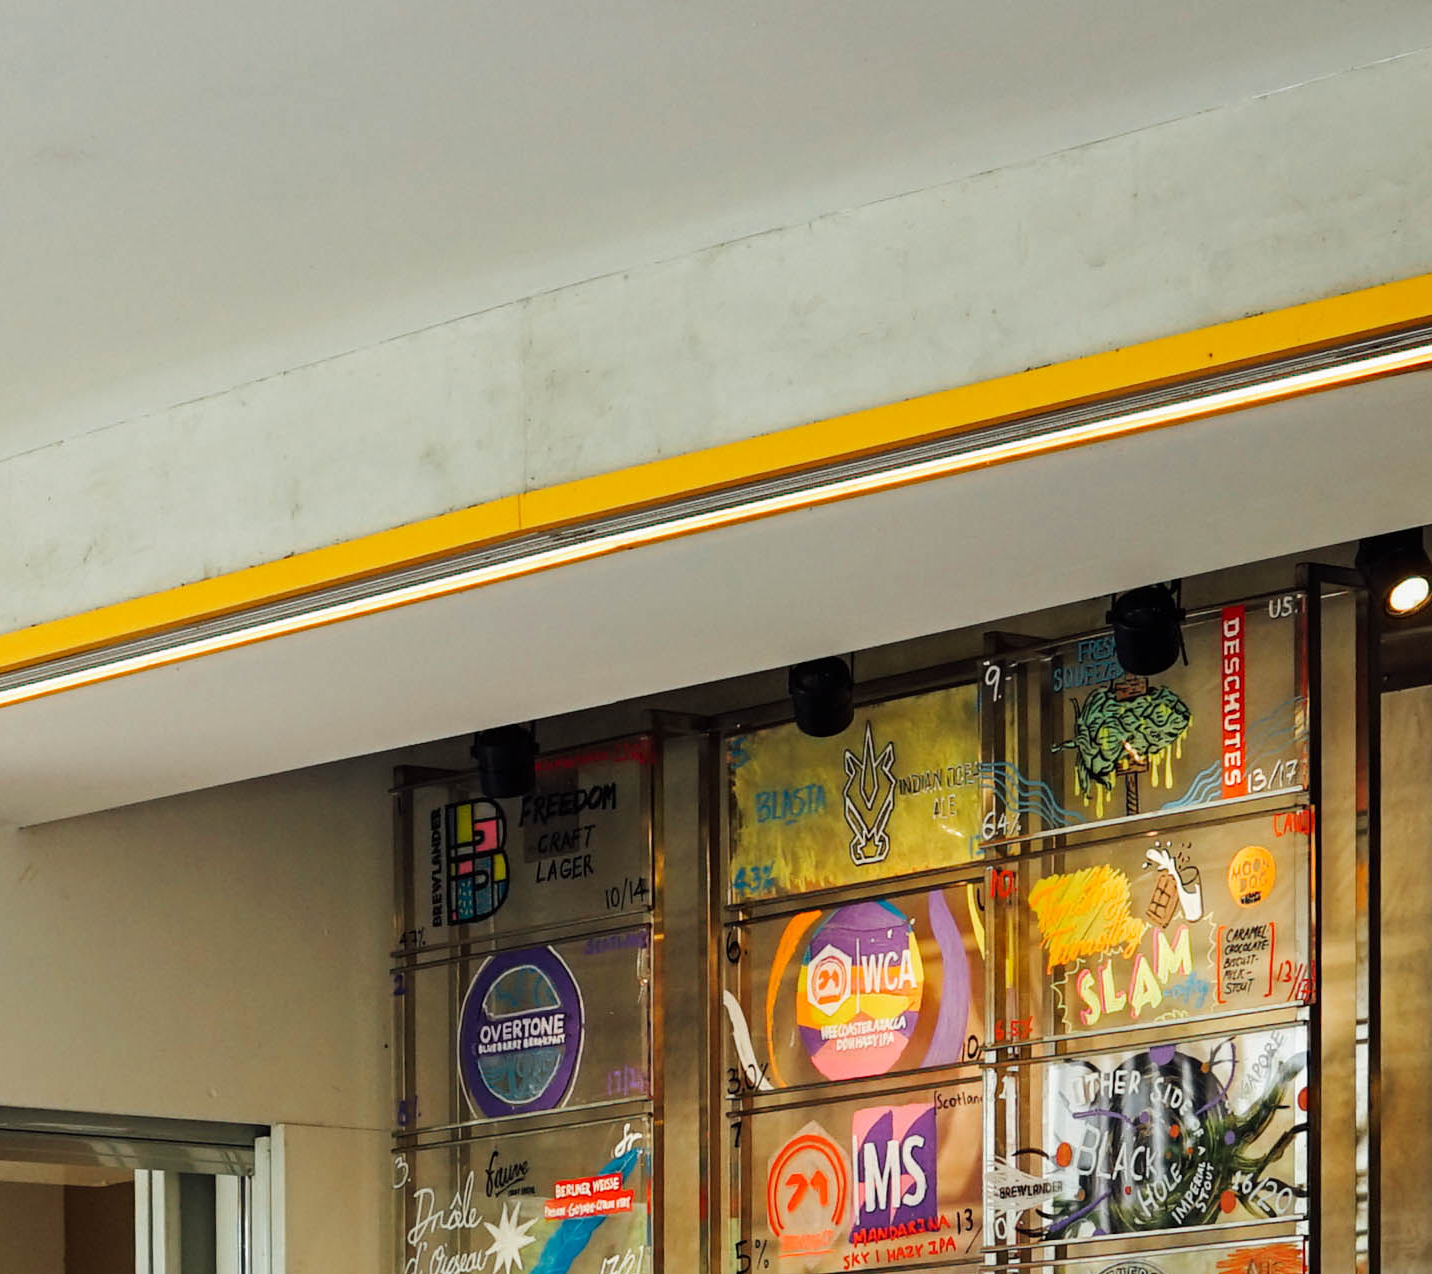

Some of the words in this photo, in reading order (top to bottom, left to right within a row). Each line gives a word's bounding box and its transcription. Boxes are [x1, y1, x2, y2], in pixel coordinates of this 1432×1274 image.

[1222, 616, 1241, 787] DESCHUTES
[518, 782, 617, 828] FREEDOM
[538, 825, 596, 855] CRAFT
[535, 854, 594, 884] LAGER
[861, 949, 918, 994] WCA
[1076, 924, 1193, 1026] SLAM
[480, 1013, 566, 1043] OVERTONE
[1075, 1124, 1160, 1182] BLACK
[555, 1181, 591, 1199] BERLINER
[592, 1176, 620, 1194] WEISSE
[1137, 1162, 1183, 1218] HOLE
[1171, 1161, 1207, 1225] IMPERIAL
[1195, 1162, 1215, 1214] STOUT
[852, 1215, 951, 1248] MANDARINA
